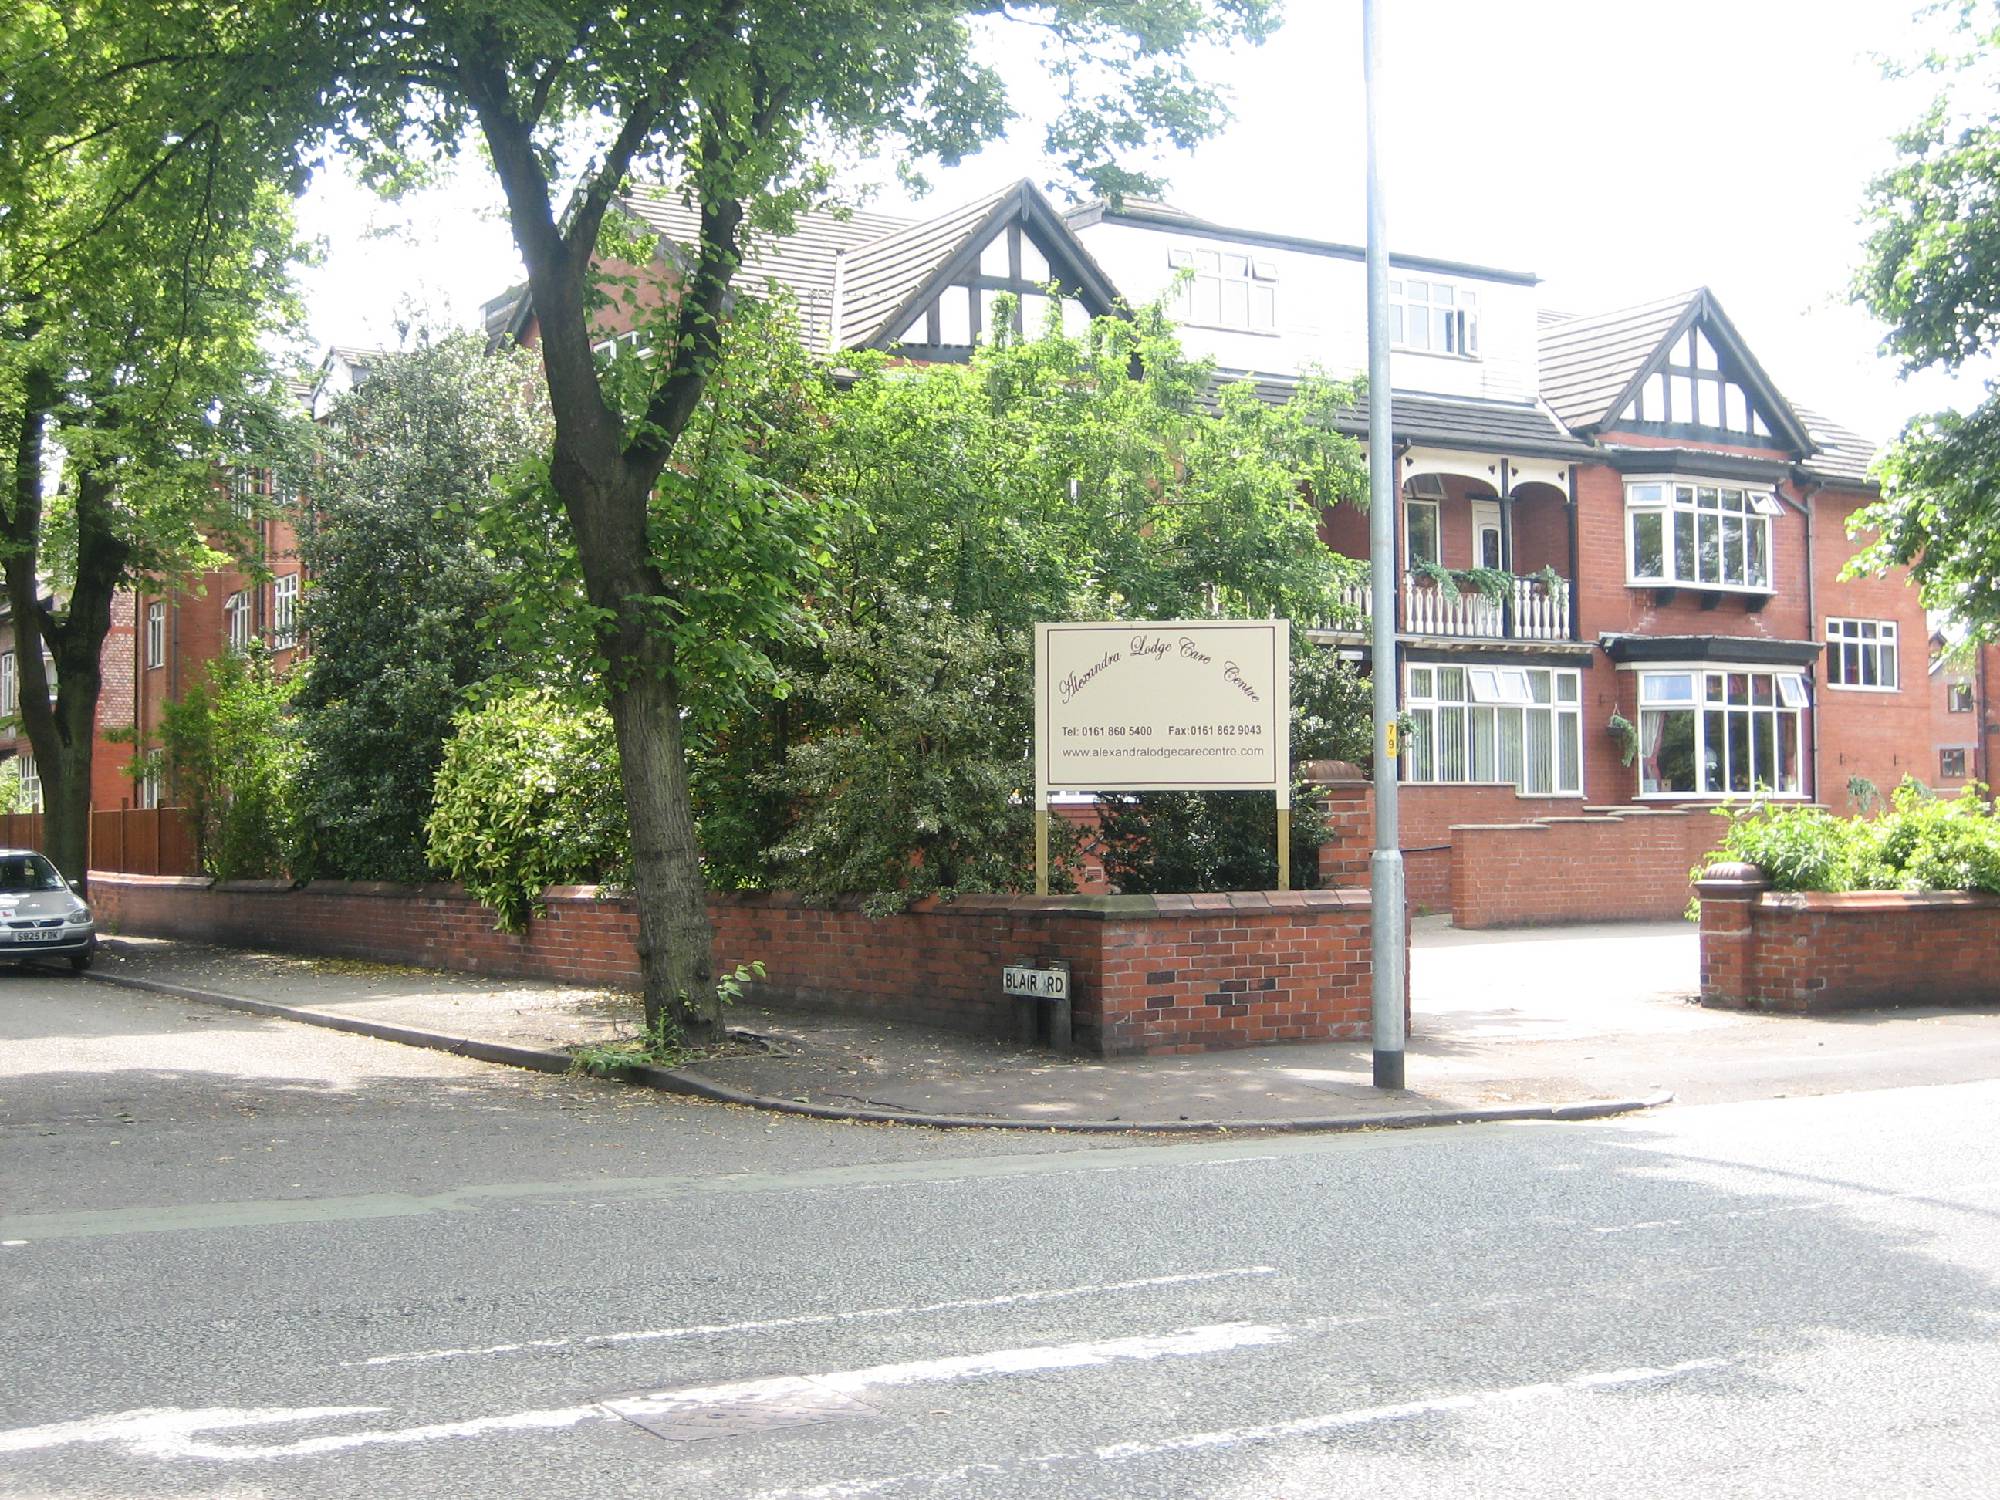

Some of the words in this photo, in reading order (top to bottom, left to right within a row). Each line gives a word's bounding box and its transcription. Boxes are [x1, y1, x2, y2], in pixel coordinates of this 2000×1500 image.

[1059, 650, 1121, 704] Alexandra
[1130, 635, 1172, 661] Lodge
[1179, 637, 1212, 665] Care
[1223, 660, 1260, 703] Centre
[1062, 726, 1079, 737] Tel:
[1082, 726, 1105, 736] 0161
[1108, 726, 1126, 736] 860
[1129, 726, 1152, 736] 5400
[1217, 725, 1235, 735] 862
[1237, 725, 1262, 735] 9043
[1062, 747, 1264, 759] www.alexandralodgecarecentre.com
[1006, 973, 1037, 992] BLAIR
